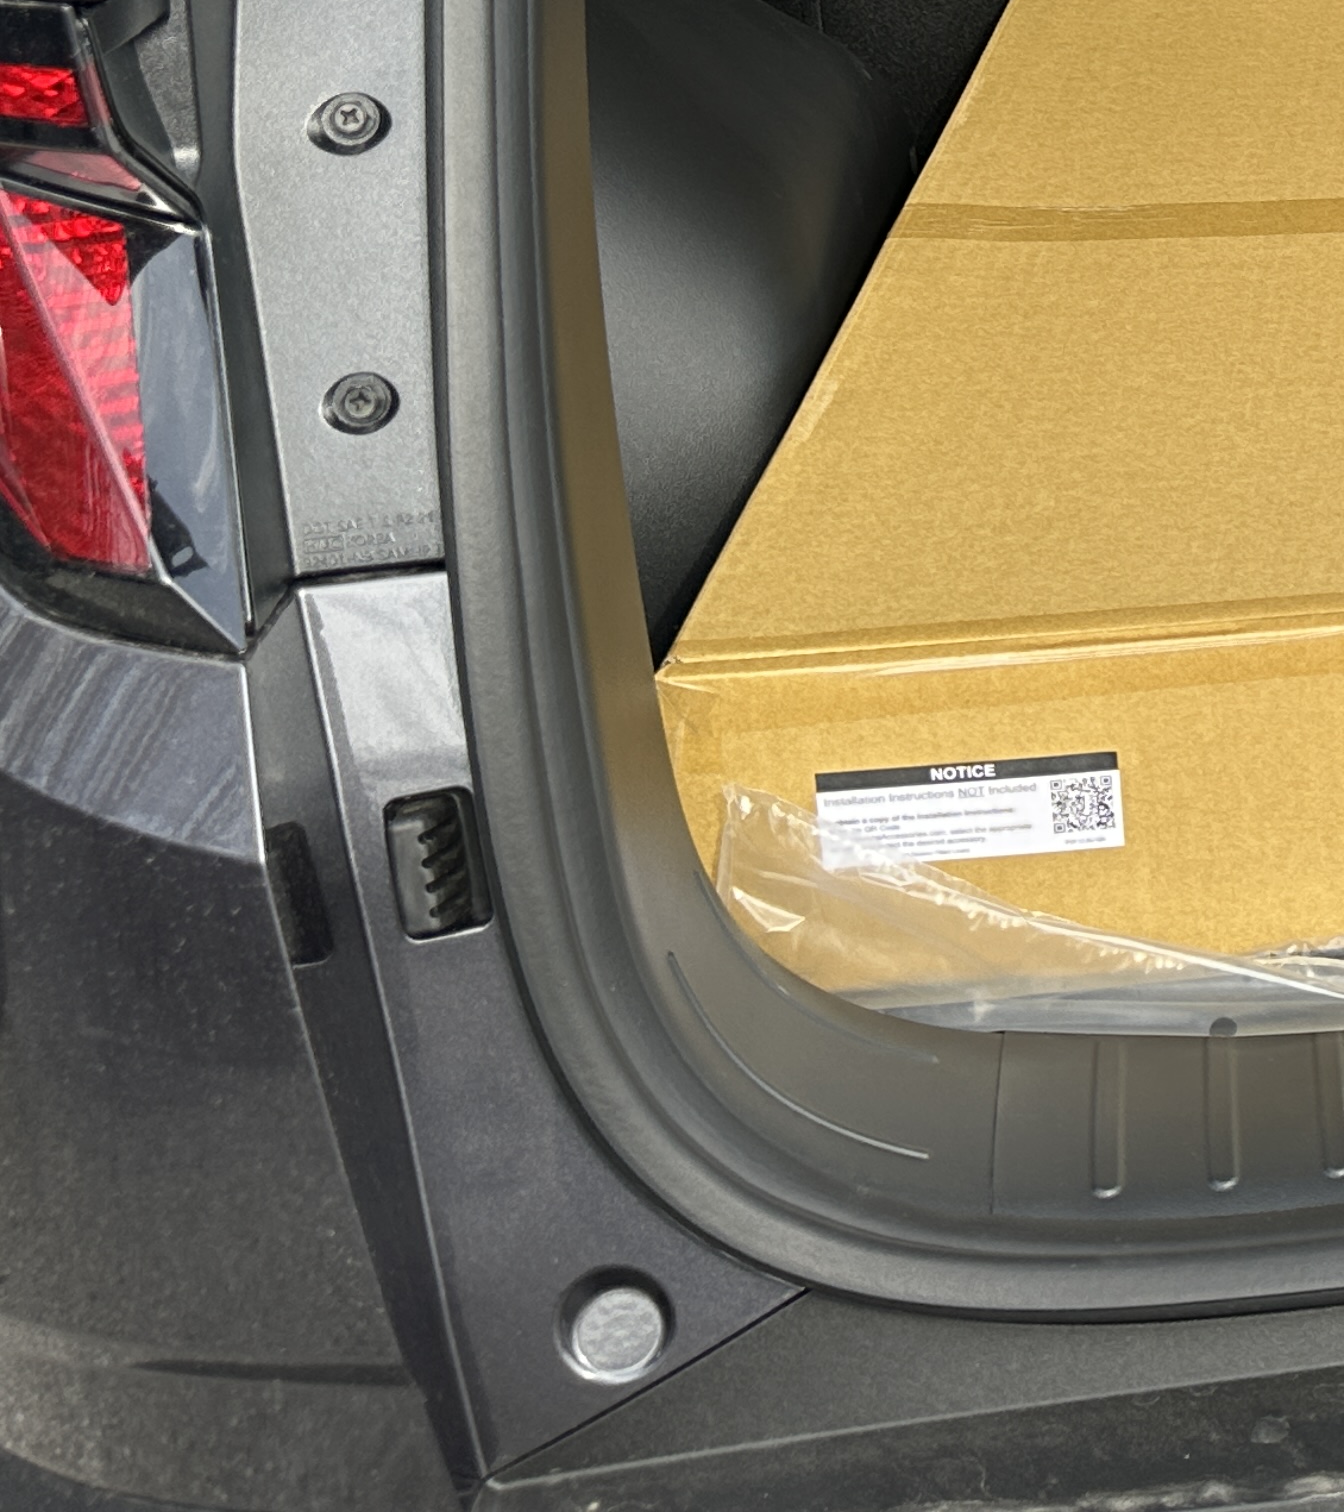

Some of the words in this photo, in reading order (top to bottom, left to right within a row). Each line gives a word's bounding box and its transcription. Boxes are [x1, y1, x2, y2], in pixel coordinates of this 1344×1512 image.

[930, 764, 996, 781] NOTICE
[823, 794, 886, 808] Installation
[889, 789, 955, 803] Instructions
[958, 786, 985, 799] NOT
[988, 783, 1038, 795] Included
